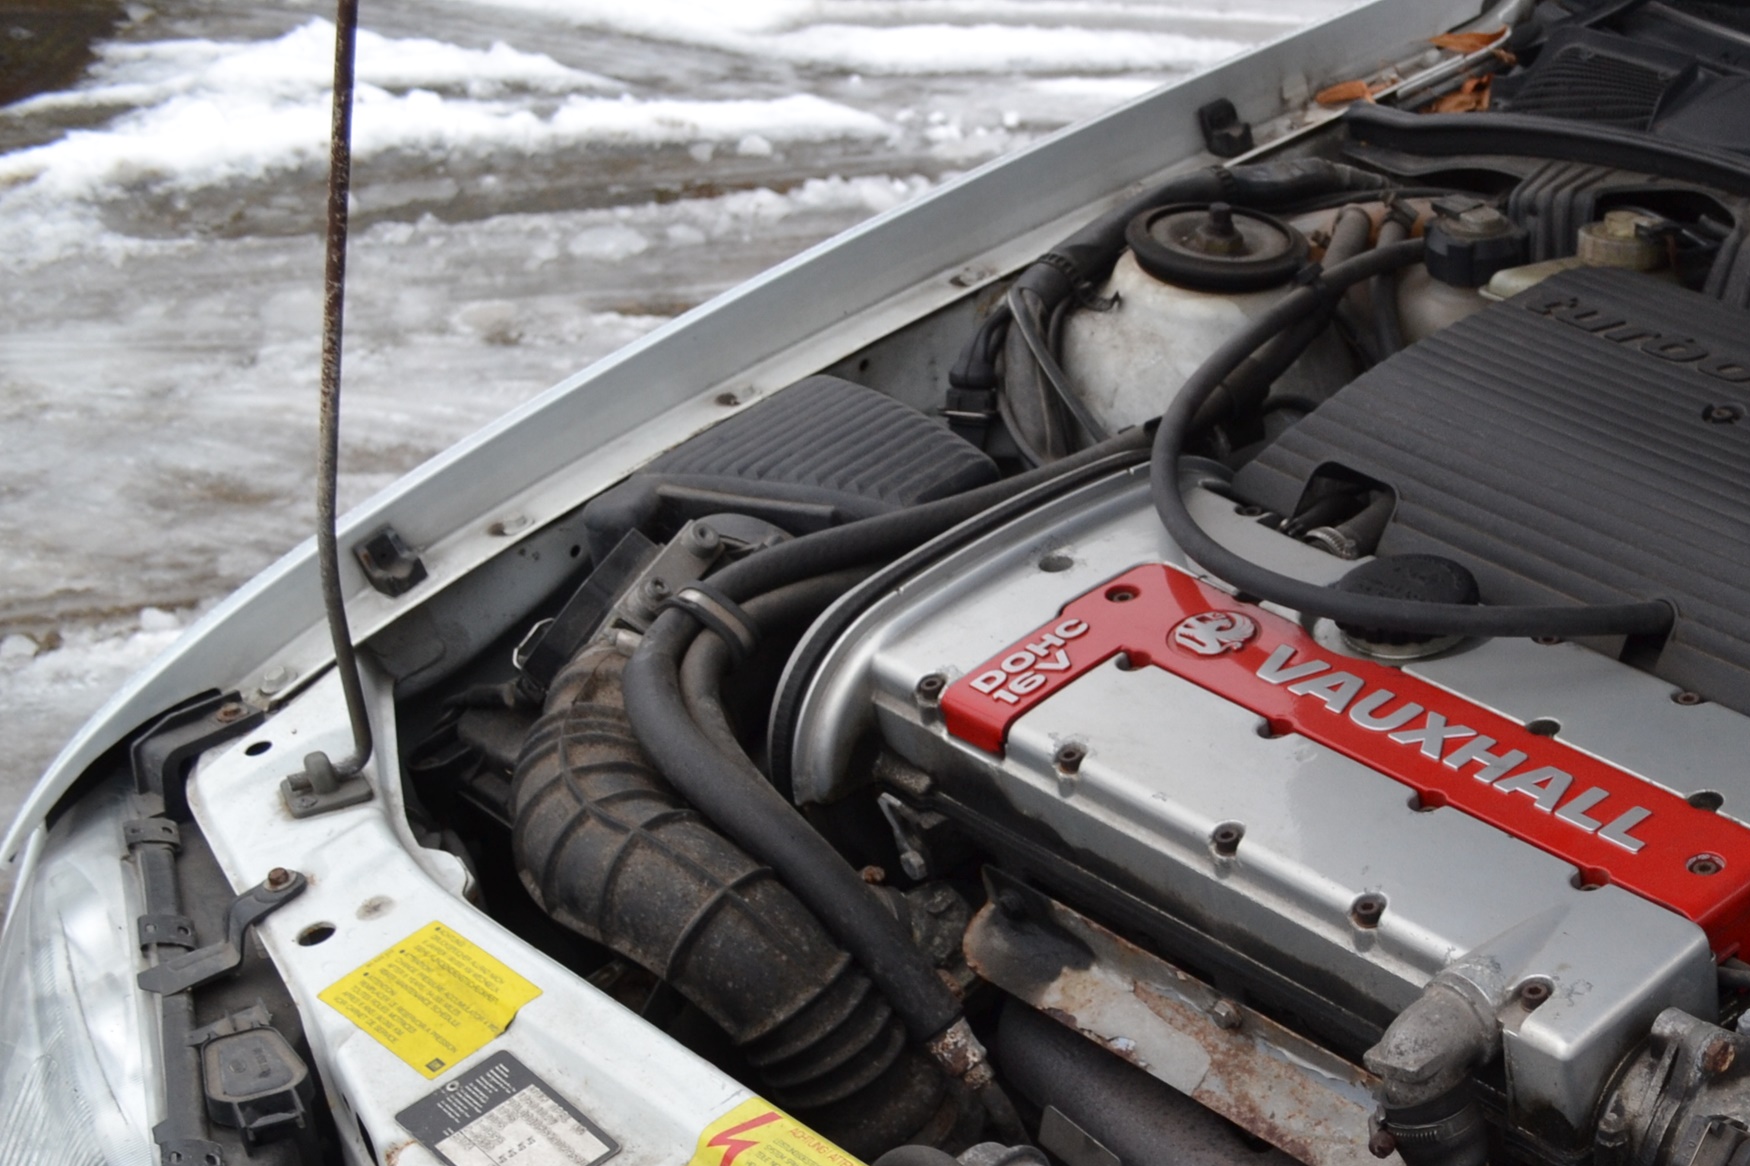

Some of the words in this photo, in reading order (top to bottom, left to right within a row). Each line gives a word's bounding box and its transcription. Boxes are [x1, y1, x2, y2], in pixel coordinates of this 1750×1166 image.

[970, 617, 1091, 696] DOHC
[991, 648, 1072, 705] 16V
[1255, 644, 1653, 855] VAUXHALL
